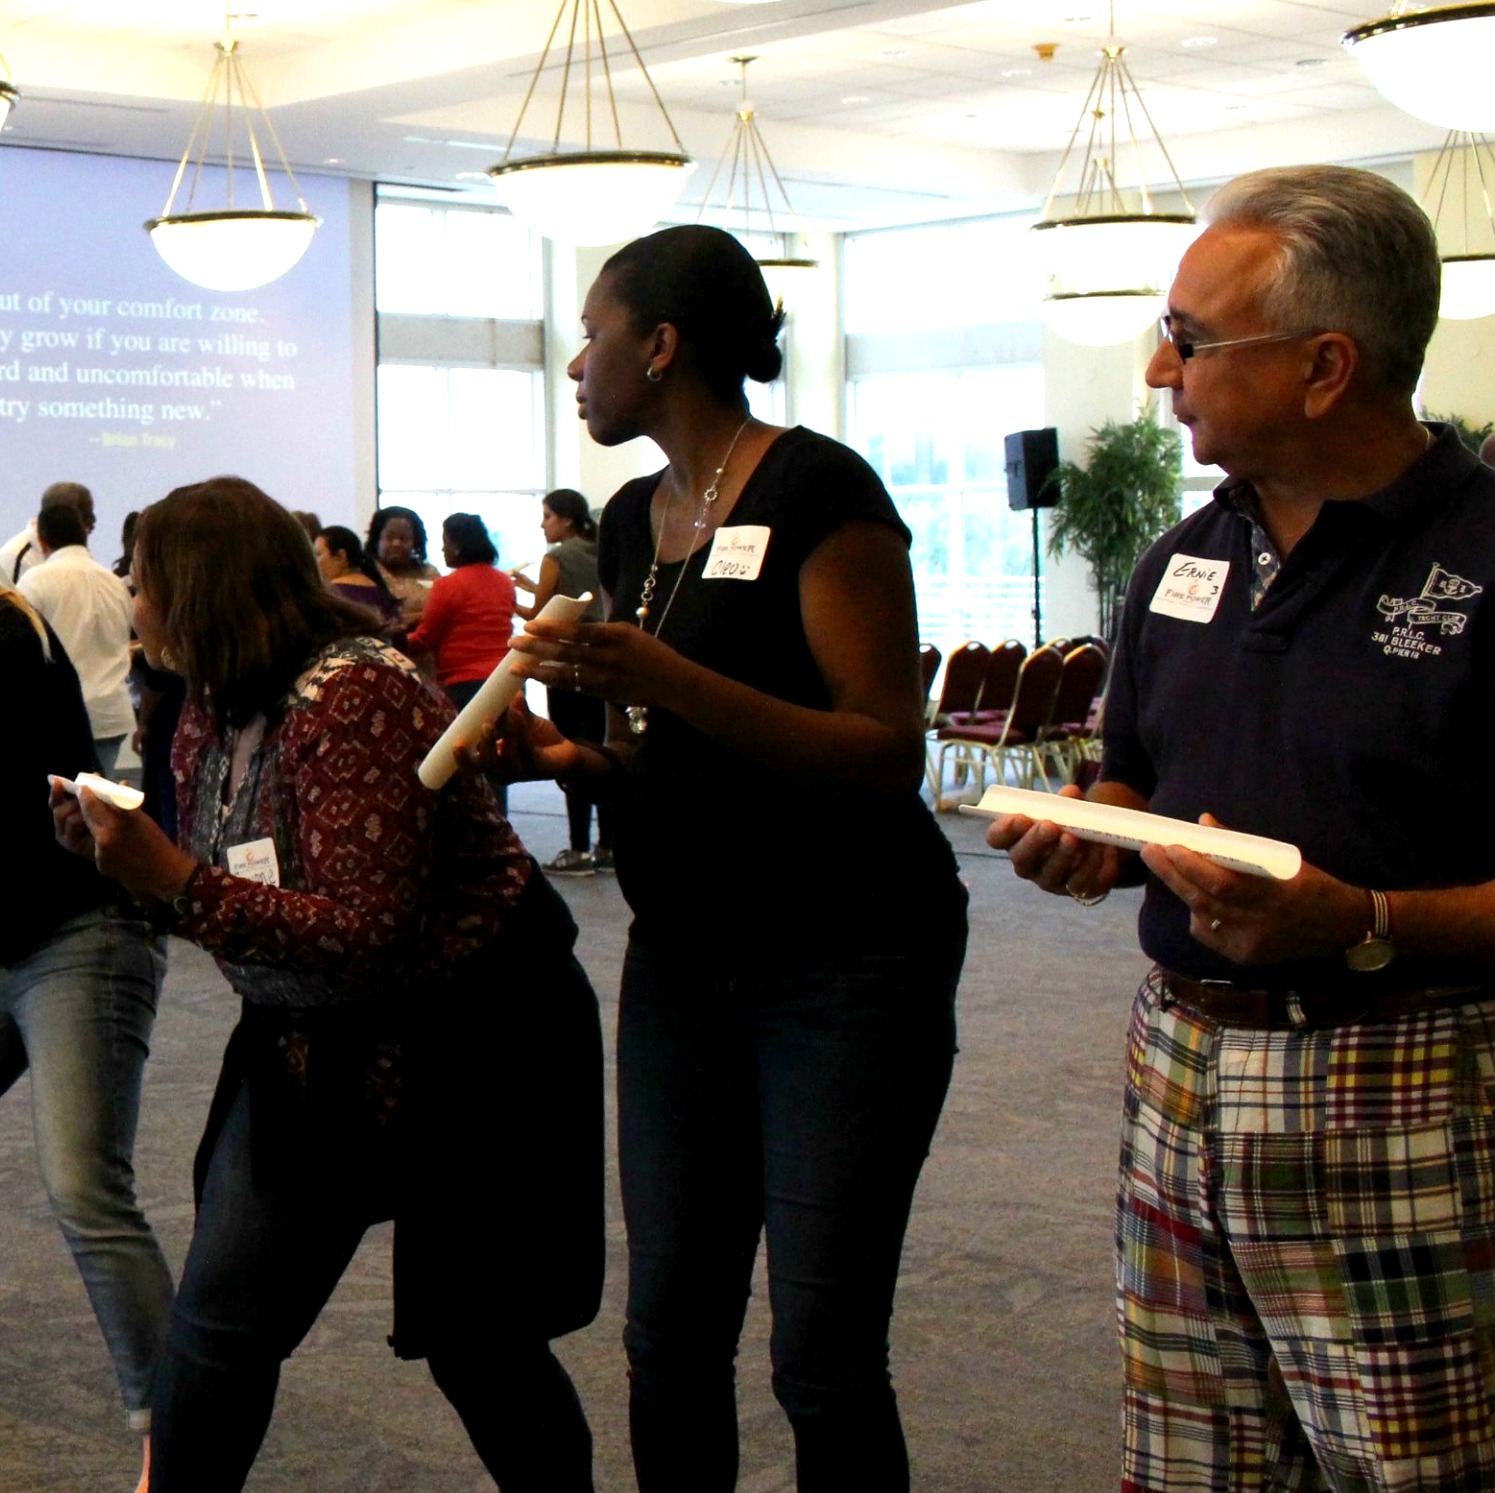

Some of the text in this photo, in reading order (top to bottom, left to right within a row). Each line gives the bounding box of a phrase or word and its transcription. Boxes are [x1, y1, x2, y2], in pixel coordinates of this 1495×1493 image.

[28, 291, 54, 312] of
[59, 297, 112, 319] your
[117, 298, 203, 321] comfort
[210, 305, 265, 323] zone.
[21, 330, 79, 352] grow
[87, 327, 106, 350] if
[111, 334, 152, 357] you
[158, 335, 192, 352] are
[198, 332, 271, 361] willing
[277, 339, 298, 358] to
[28, 361, 69, 383] and
[76, 364, 234, 388] uncomfortable
[240, 368, 295, 390] when
[38, 396, 154, 425] something
[1210, 585, 1220, 596] 3
[1371, 631, 1442, 656] 381 BLEEKER
